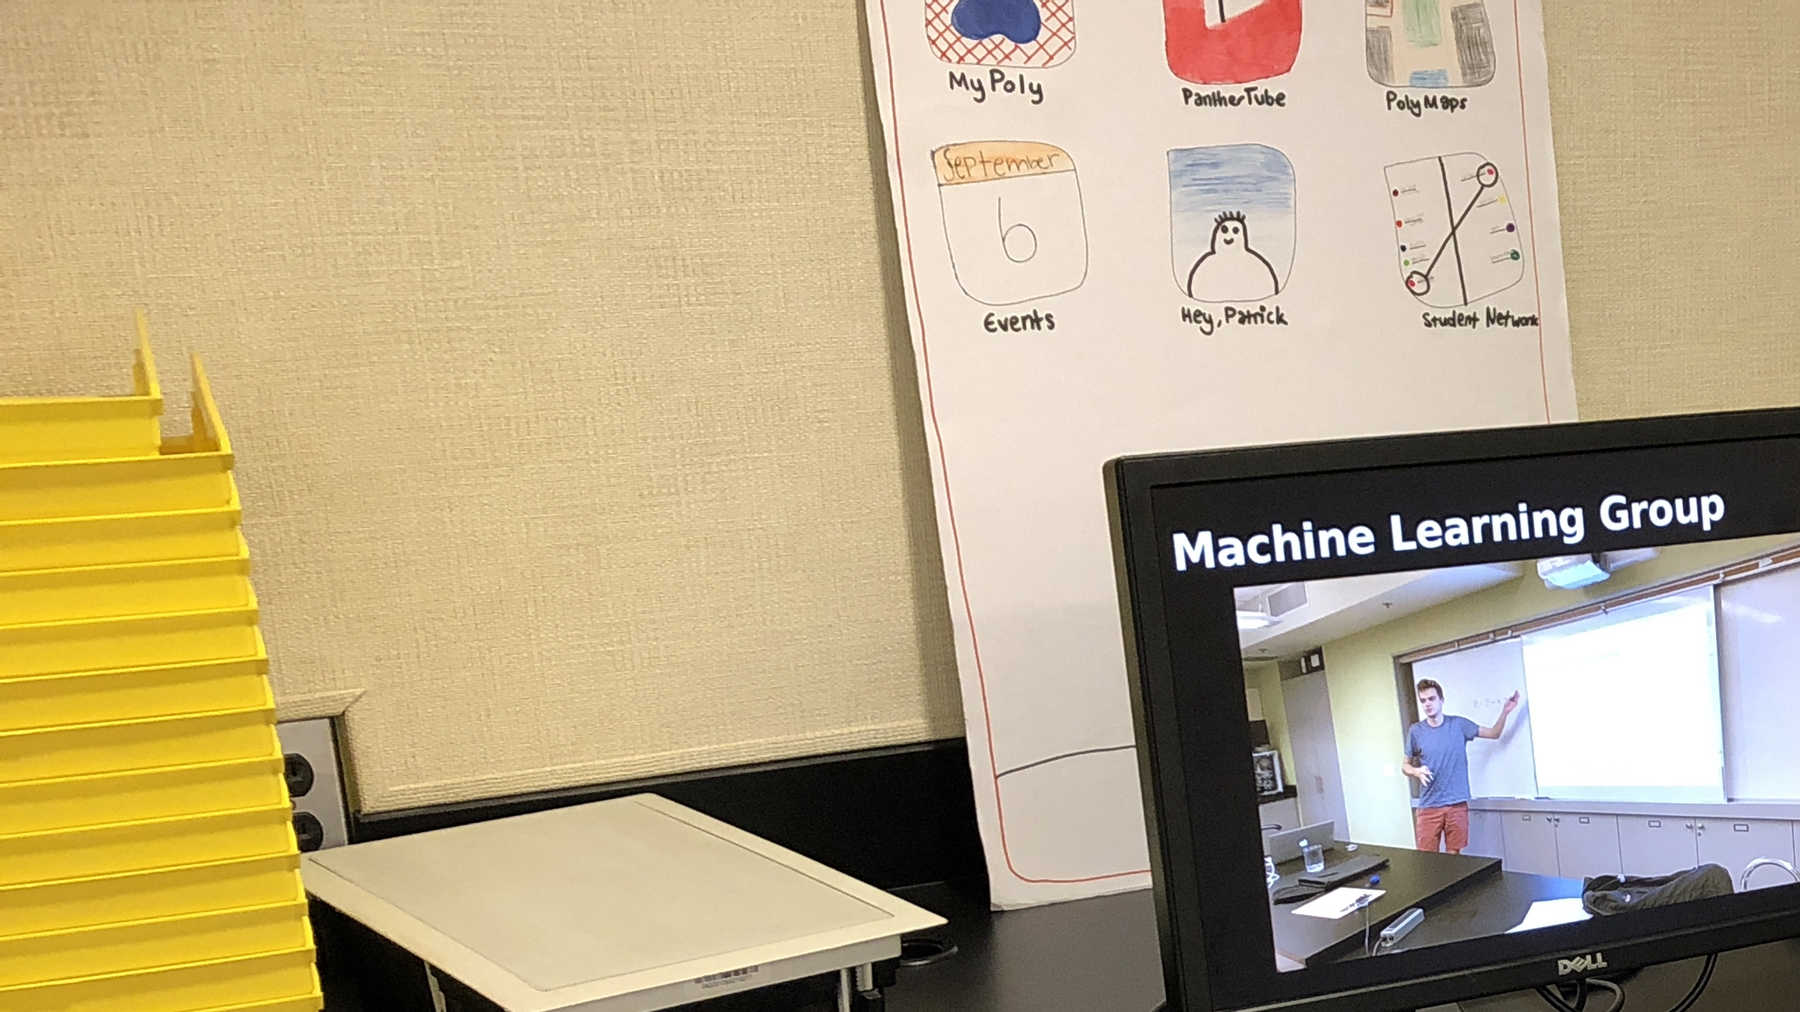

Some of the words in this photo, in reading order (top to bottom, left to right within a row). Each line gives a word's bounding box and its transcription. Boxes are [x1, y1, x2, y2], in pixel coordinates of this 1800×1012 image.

[948, 70, 986, 103] My
[989, 68, 1044, 105] Poly
[1386, 90, 1422, 118] Poly
[943, 147, 1061, 182] September
[983, 308, 1056, 333] Events
[1224, 305, 1289, 327] Patrick
[1421, 310, 1480, 330] Student
[1485, 306, 1540, 329] Network
[1171, 520, 1377, 572] Machine
[1389, 503, 1585, 552] Learning
[1599, 493, 1726, 532] Group
[1557, 952, 1608, 976] DELL
